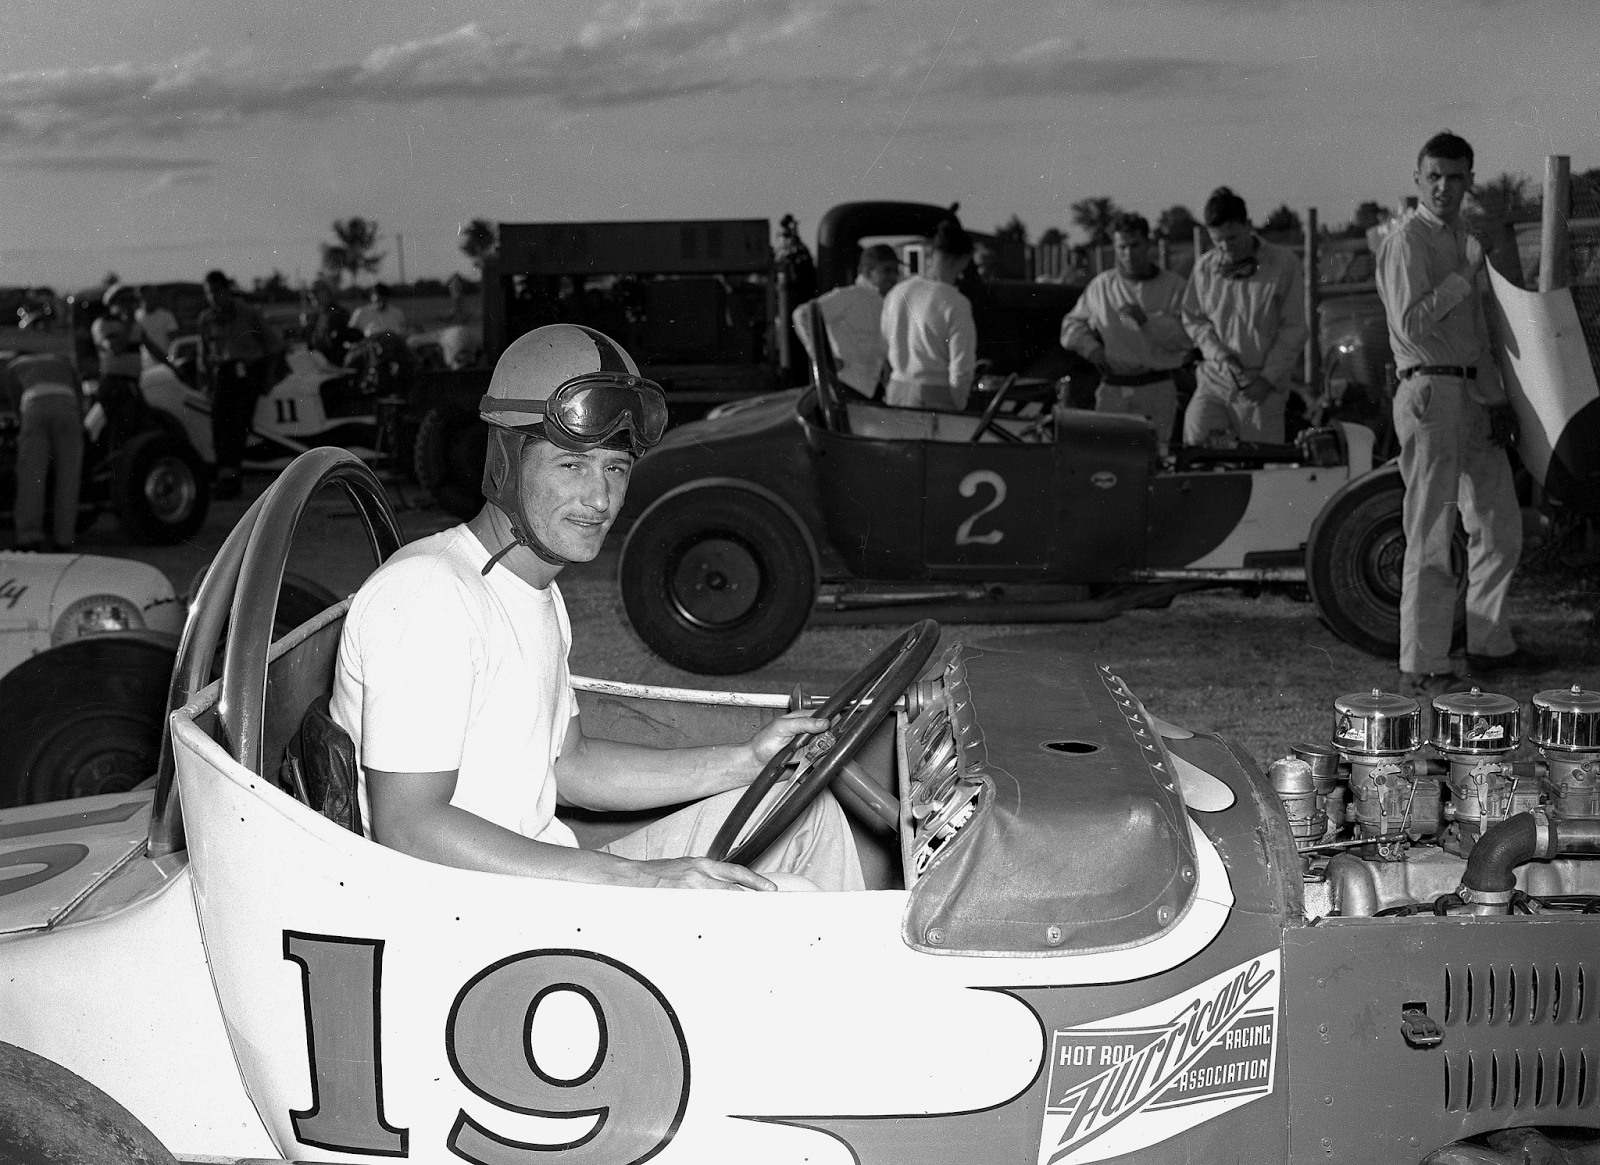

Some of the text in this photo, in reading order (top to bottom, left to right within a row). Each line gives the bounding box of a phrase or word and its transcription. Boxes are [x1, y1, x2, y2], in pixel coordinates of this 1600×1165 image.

[275, 398, 299, 424] 11
[955, 469, 1007, 546] 2
[282, 928, 691, 1165] 19
[1225, 1024, 1271, 1051] RACING
[1059, 1044, 1135, 1066] HOT ROD
[1179, 1058, 1269, 1092] ASSOCIATION
